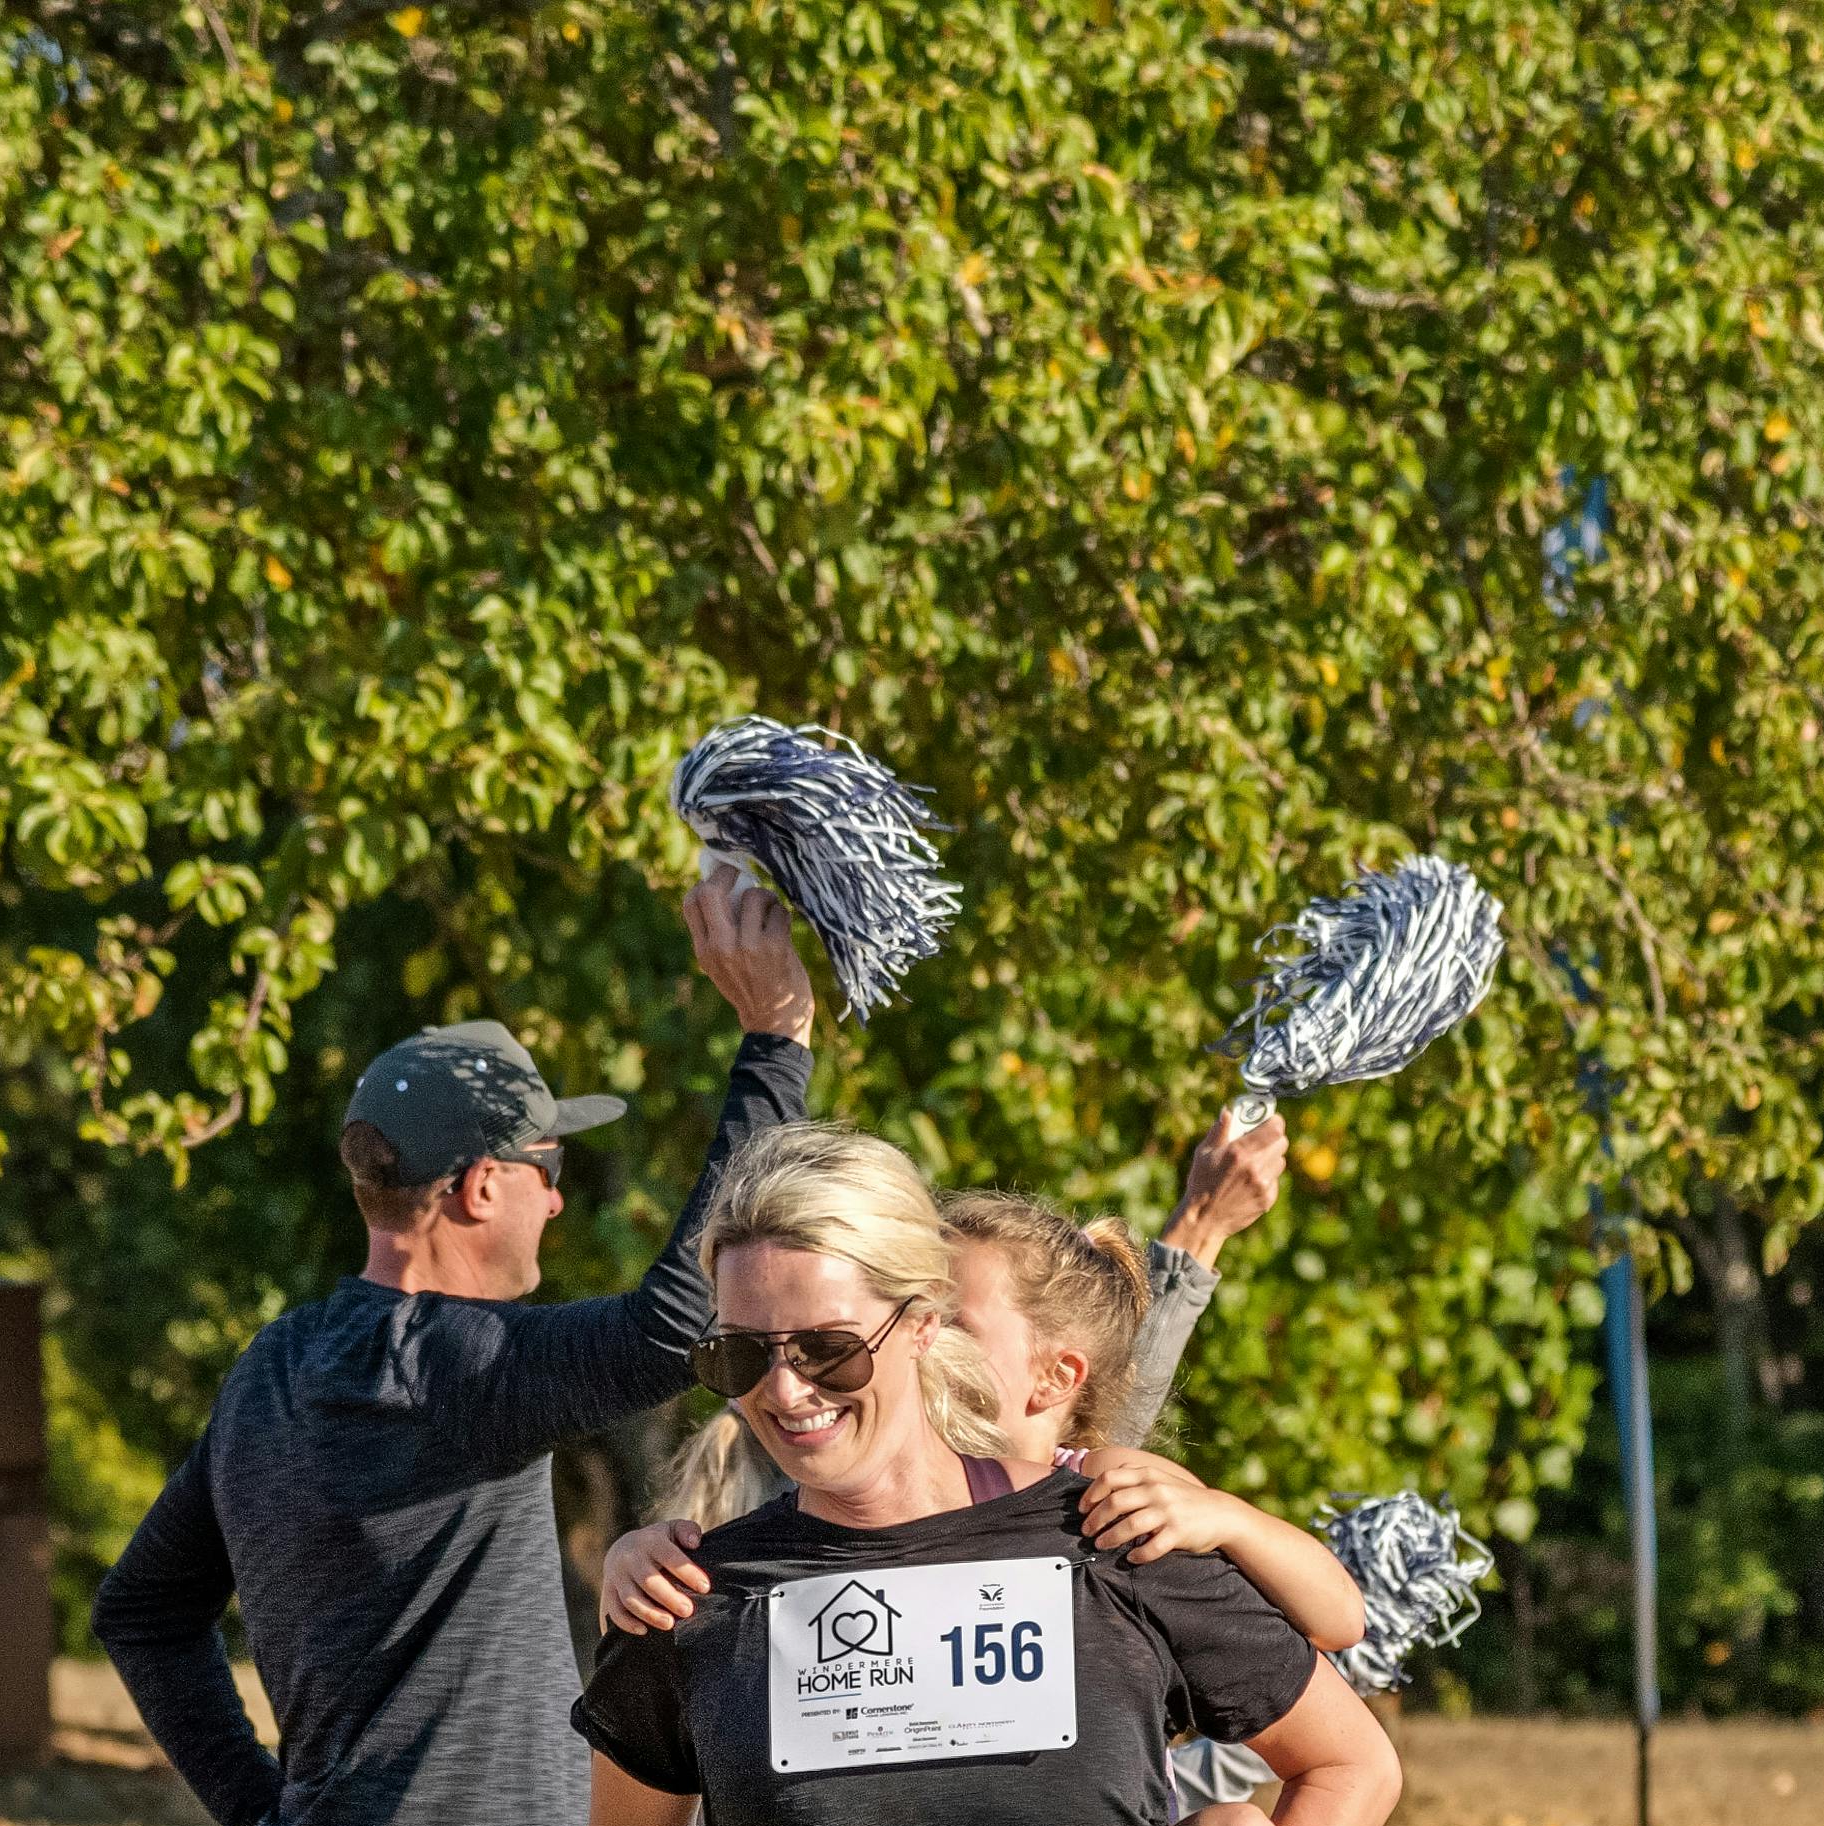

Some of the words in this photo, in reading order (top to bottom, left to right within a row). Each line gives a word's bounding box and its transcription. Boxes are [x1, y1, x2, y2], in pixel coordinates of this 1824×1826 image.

[797, 1657, 914, 1676] WINDERMERE
[940, 1621, 1044, 1687] 156
[797, 1671, 861, 1695] HOME
[870, 1666, 914, 1687] RUN
